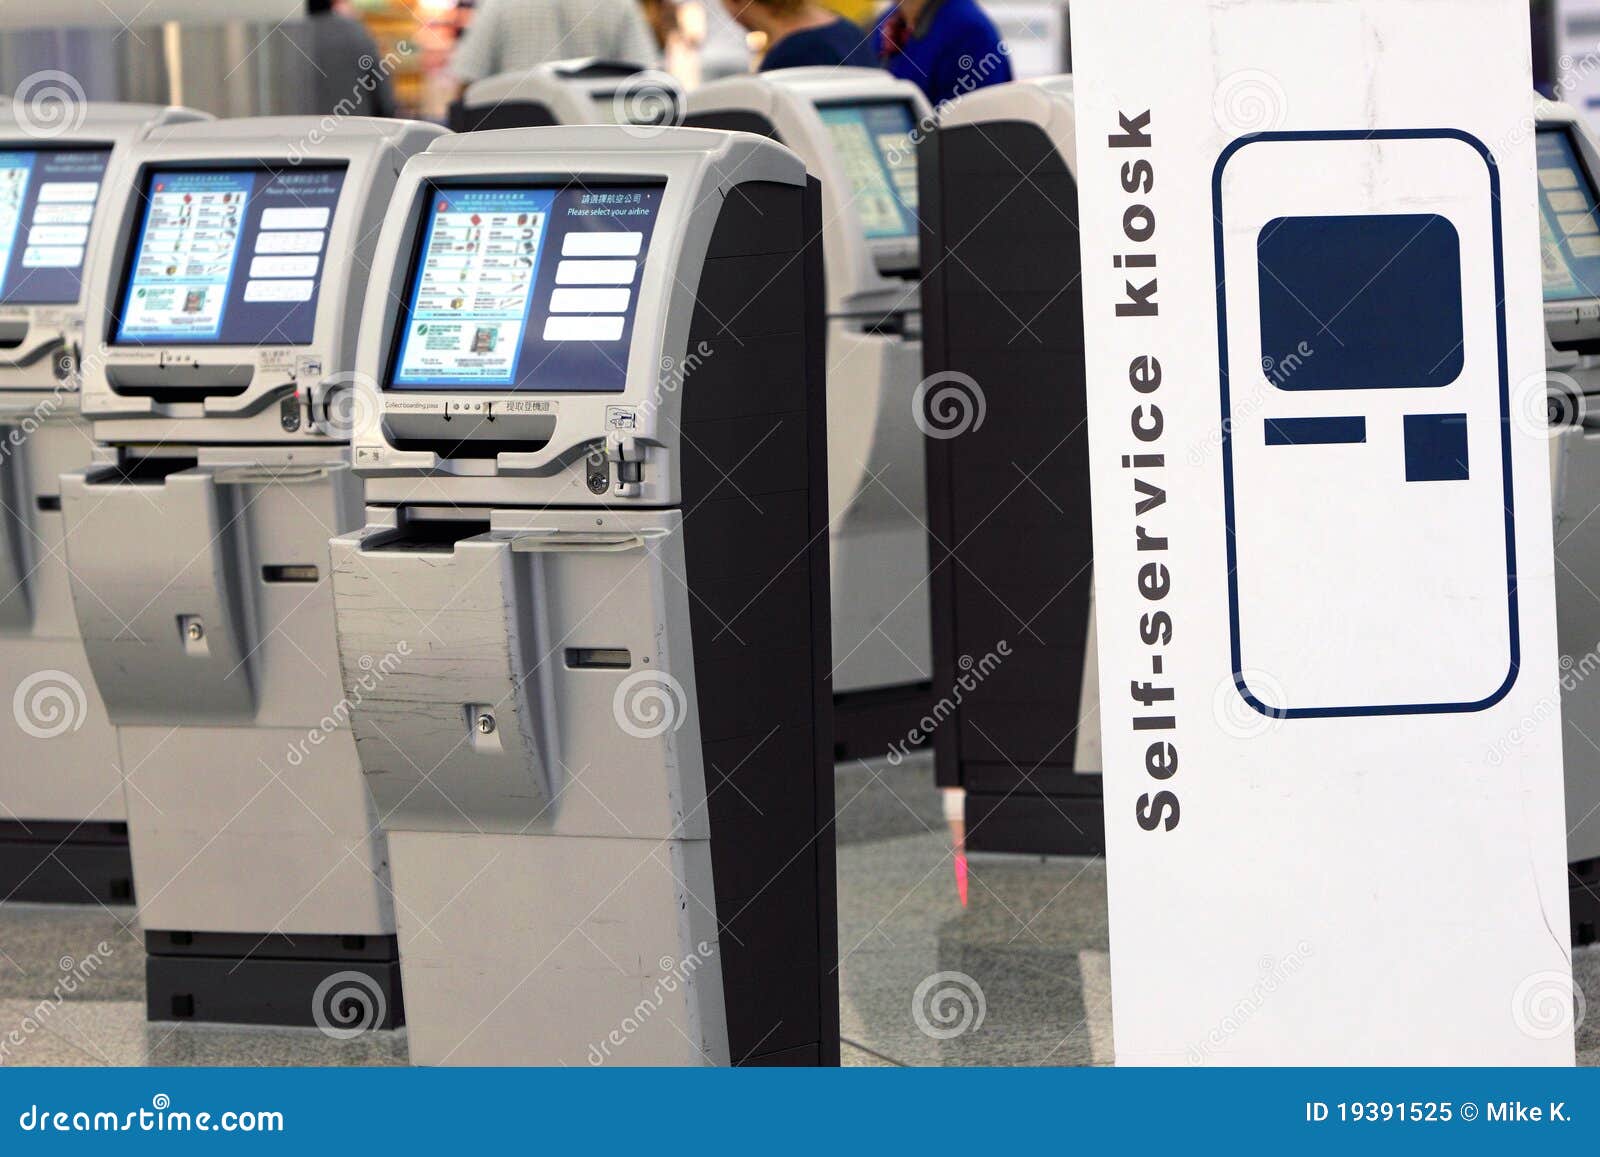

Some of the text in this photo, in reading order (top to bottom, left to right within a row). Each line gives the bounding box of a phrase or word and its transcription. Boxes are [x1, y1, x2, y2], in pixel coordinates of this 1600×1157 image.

[567, 207, 650, 218] Please select your airline
[385, 401, 403, 409] Collect
[1108, 109, 1181, 833] Self-service kiosk
